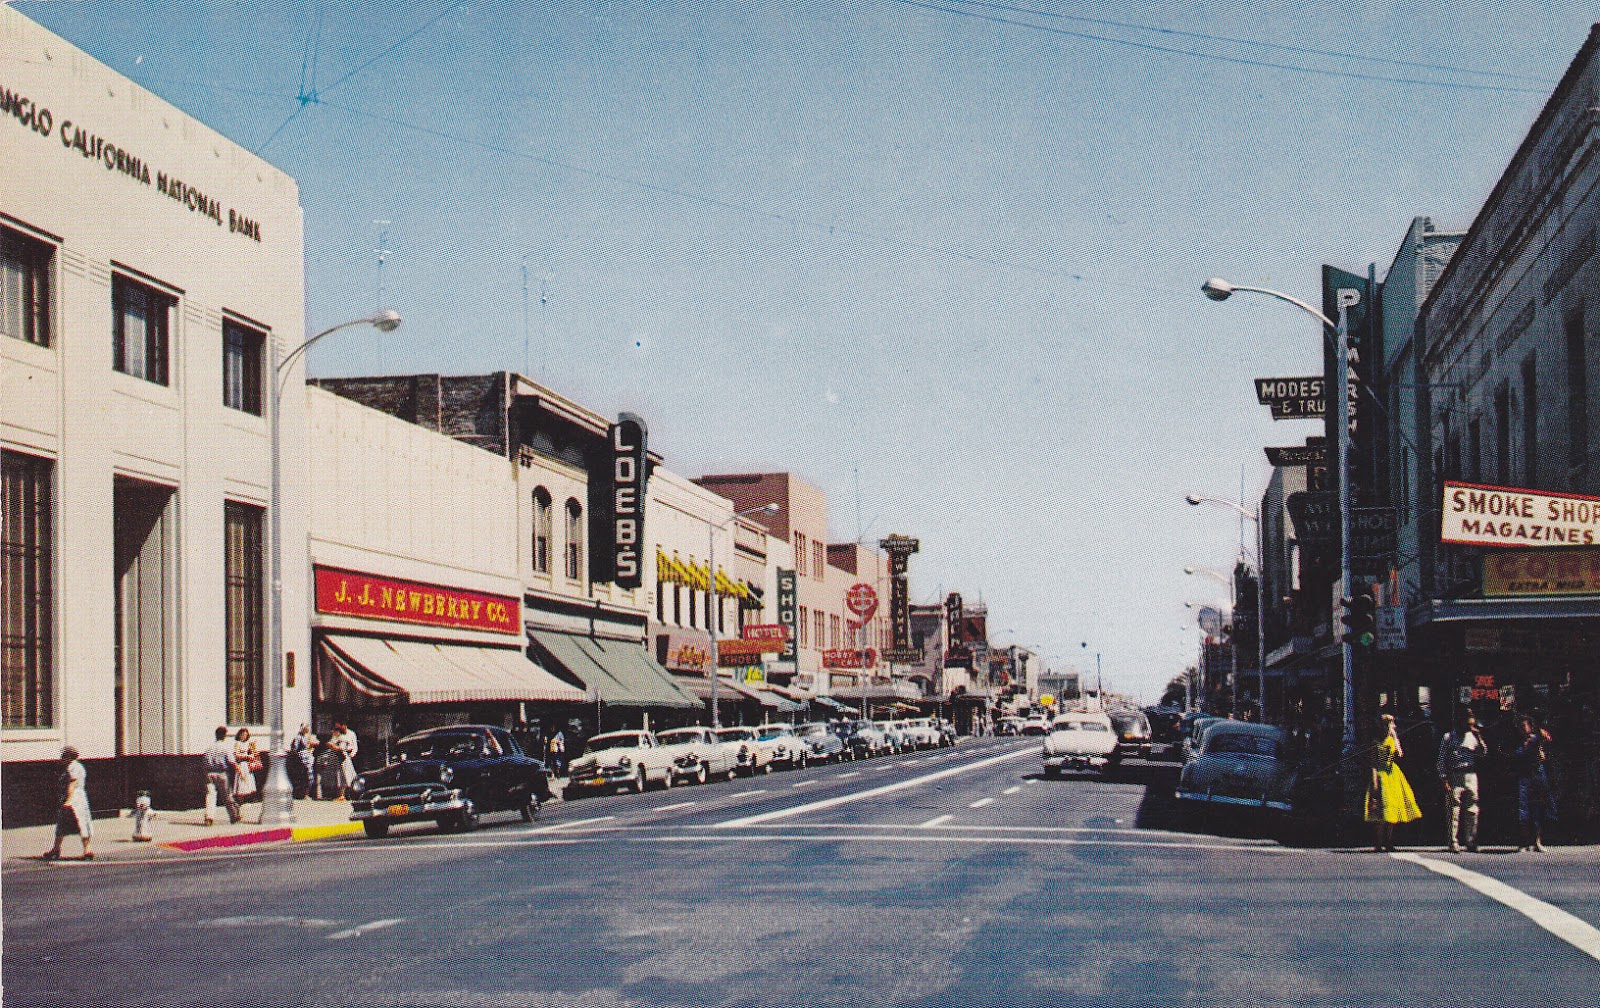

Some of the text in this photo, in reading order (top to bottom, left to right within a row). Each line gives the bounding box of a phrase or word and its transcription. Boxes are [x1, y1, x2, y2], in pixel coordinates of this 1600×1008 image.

[0, 84, 261, 242] ANGLO CALIFORNIA NATIONAL BANK
[1451, 490, 1600, 526] SMOKE SHOP
[1461, 518, 1594, 545] MAGAZINES
[334, 580, 510, 624] J. J. NEWBERRY CO.
[894, 562, 905, 635] WLLIAMS
[747, 627, 785, 639] HOTEL
[723, 654, 758, 665] SHOES
